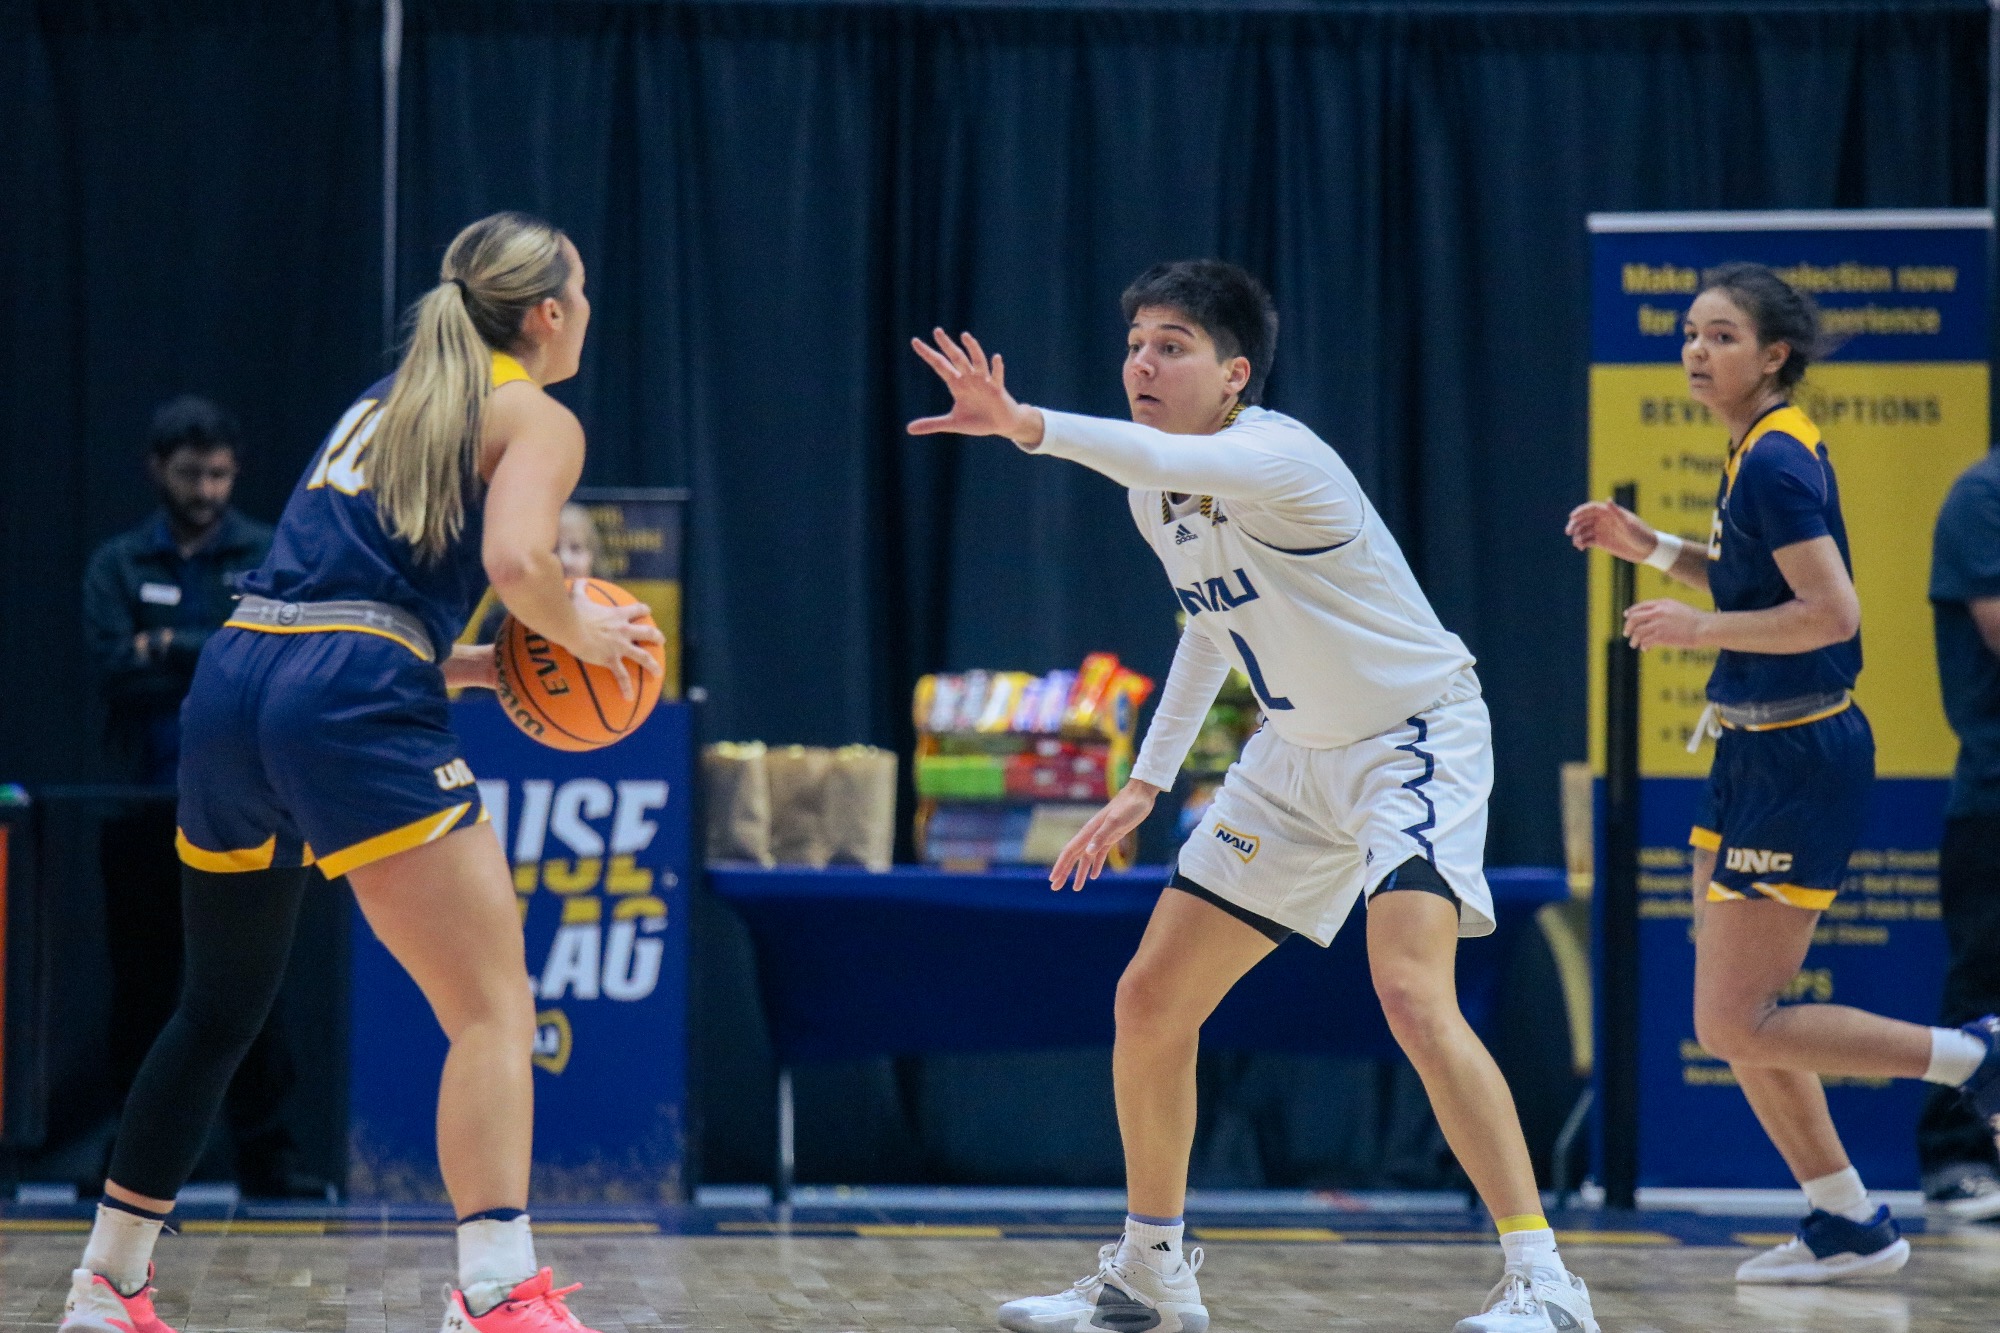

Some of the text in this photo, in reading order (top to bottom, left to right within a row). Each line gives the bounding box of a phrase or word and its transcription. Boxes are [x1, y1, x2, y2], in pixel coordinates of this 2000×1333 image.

[1622, 263, 1697, 293] Make
[1897, 266, 1957, 292] now
[1639, 304, 1677, 334] for
[1804, 396, 1944, 426] OPTIONS
[1175, 567, 1260, 617] NAU
[1227, 627, 1296, 711] 1
[433, 757, 477, 790] UN
[1215, 828, 1254, 855] NAU
[1725, 847, 1794, 875] UNC
